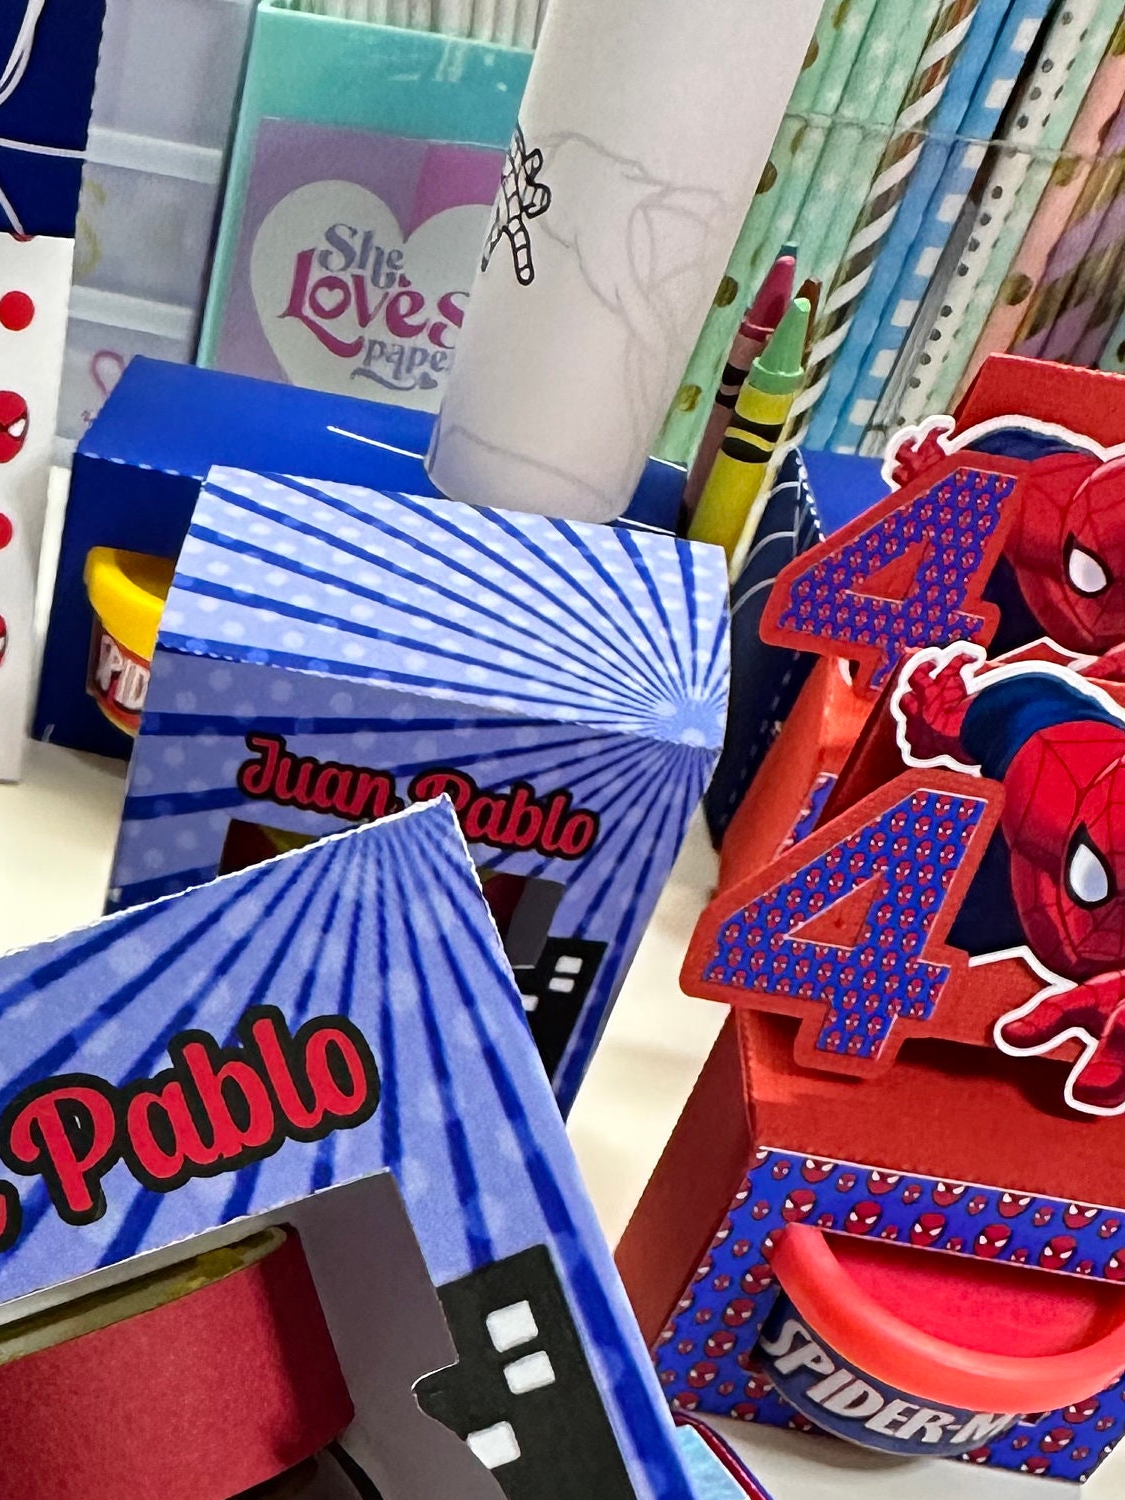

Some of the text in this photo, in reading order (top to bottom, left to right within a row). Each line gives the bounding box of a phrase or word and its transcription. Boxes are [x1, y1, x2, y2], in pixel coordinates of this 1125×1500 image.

[318, 223, 404, 289] She
[361, 339, 449, 382] pape
[237, 731, 405, 822] Juan
[681, 770, 1004, 1076] 4
[759, 1318, 1016, 1444] SPIDER-M
